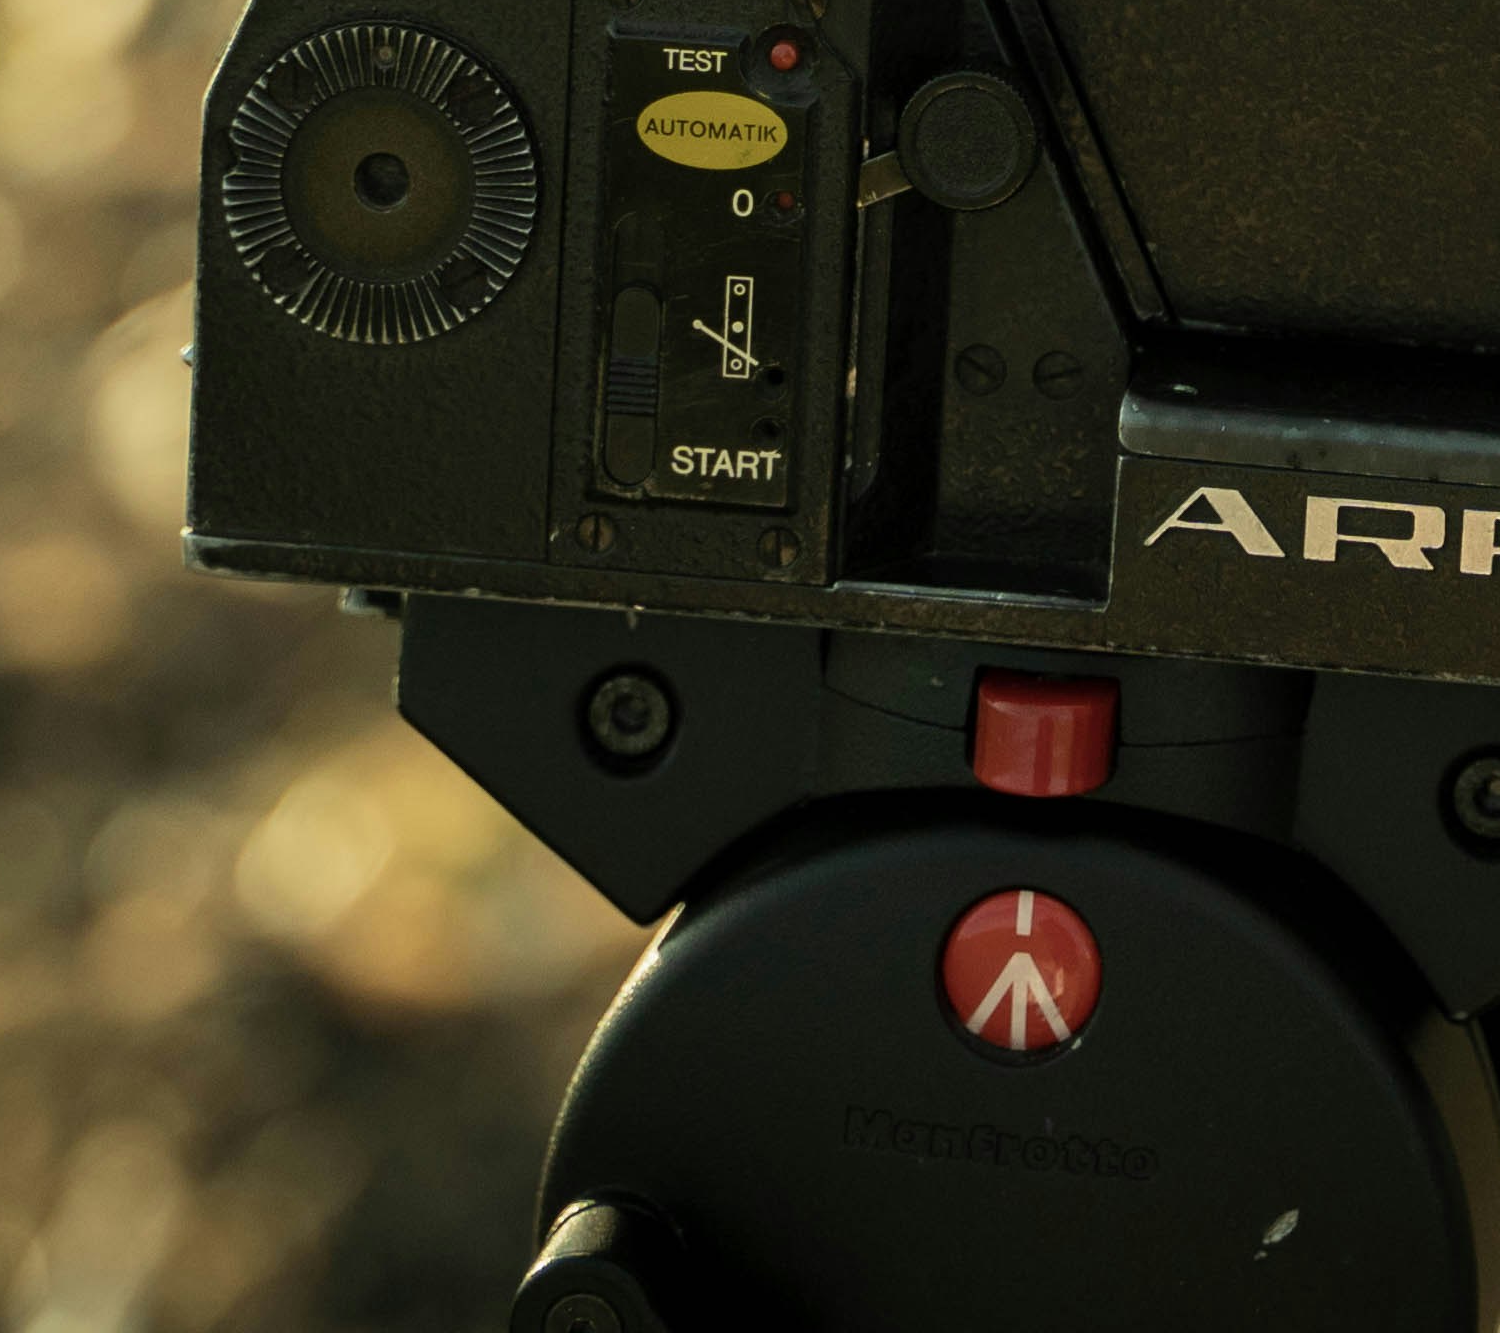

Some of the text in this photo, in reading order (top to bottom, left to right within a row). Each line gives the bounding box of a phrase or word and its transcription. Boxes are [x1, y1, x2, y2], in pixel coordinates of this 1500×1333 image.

[663, 47, 727, 74] TEST
[644, 116, 778, 144] AUTOMATIK
[671, 445, 781, 481] START
